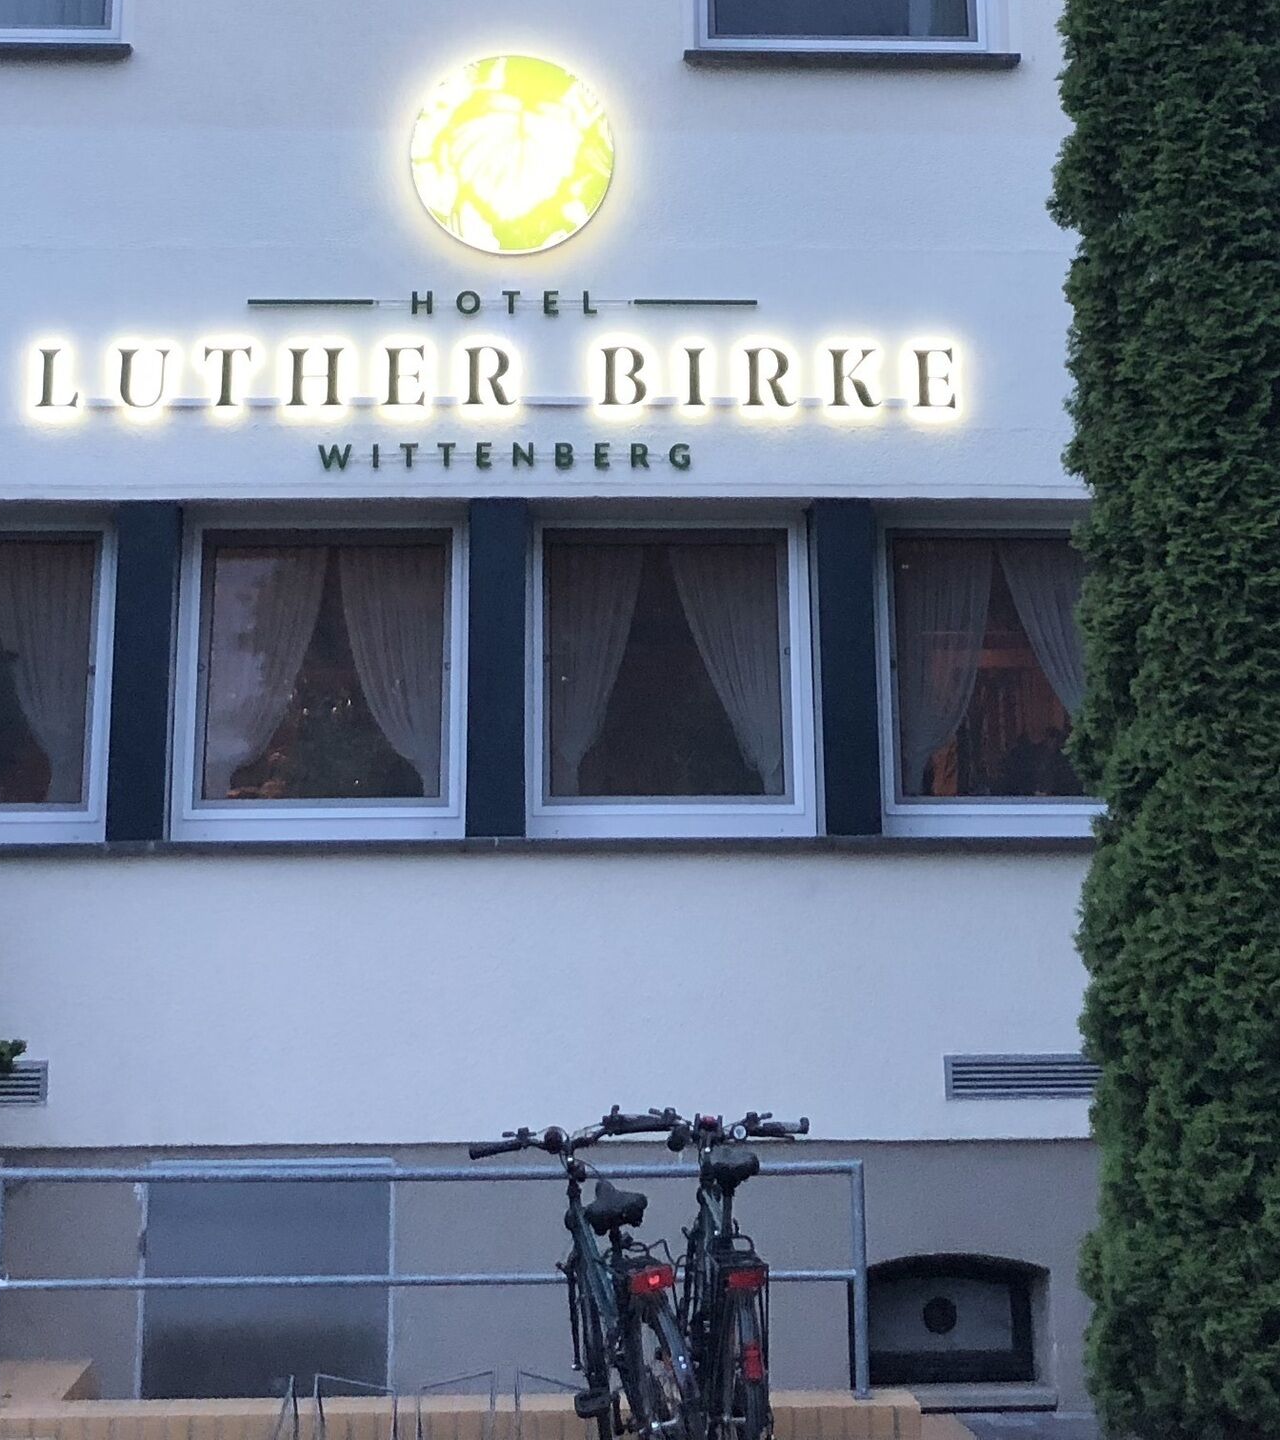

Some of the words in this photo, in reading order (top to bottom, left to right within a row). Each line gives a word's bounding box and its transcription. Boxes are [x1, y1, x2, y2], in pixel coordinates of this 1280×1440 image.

[411, 291, 598, 315] HOTEL
[35, 346, 516, 408] LUTHER
[600, 348, 956, 408] BIRKE
[318, 444, 693, 470] WITTENBERG
